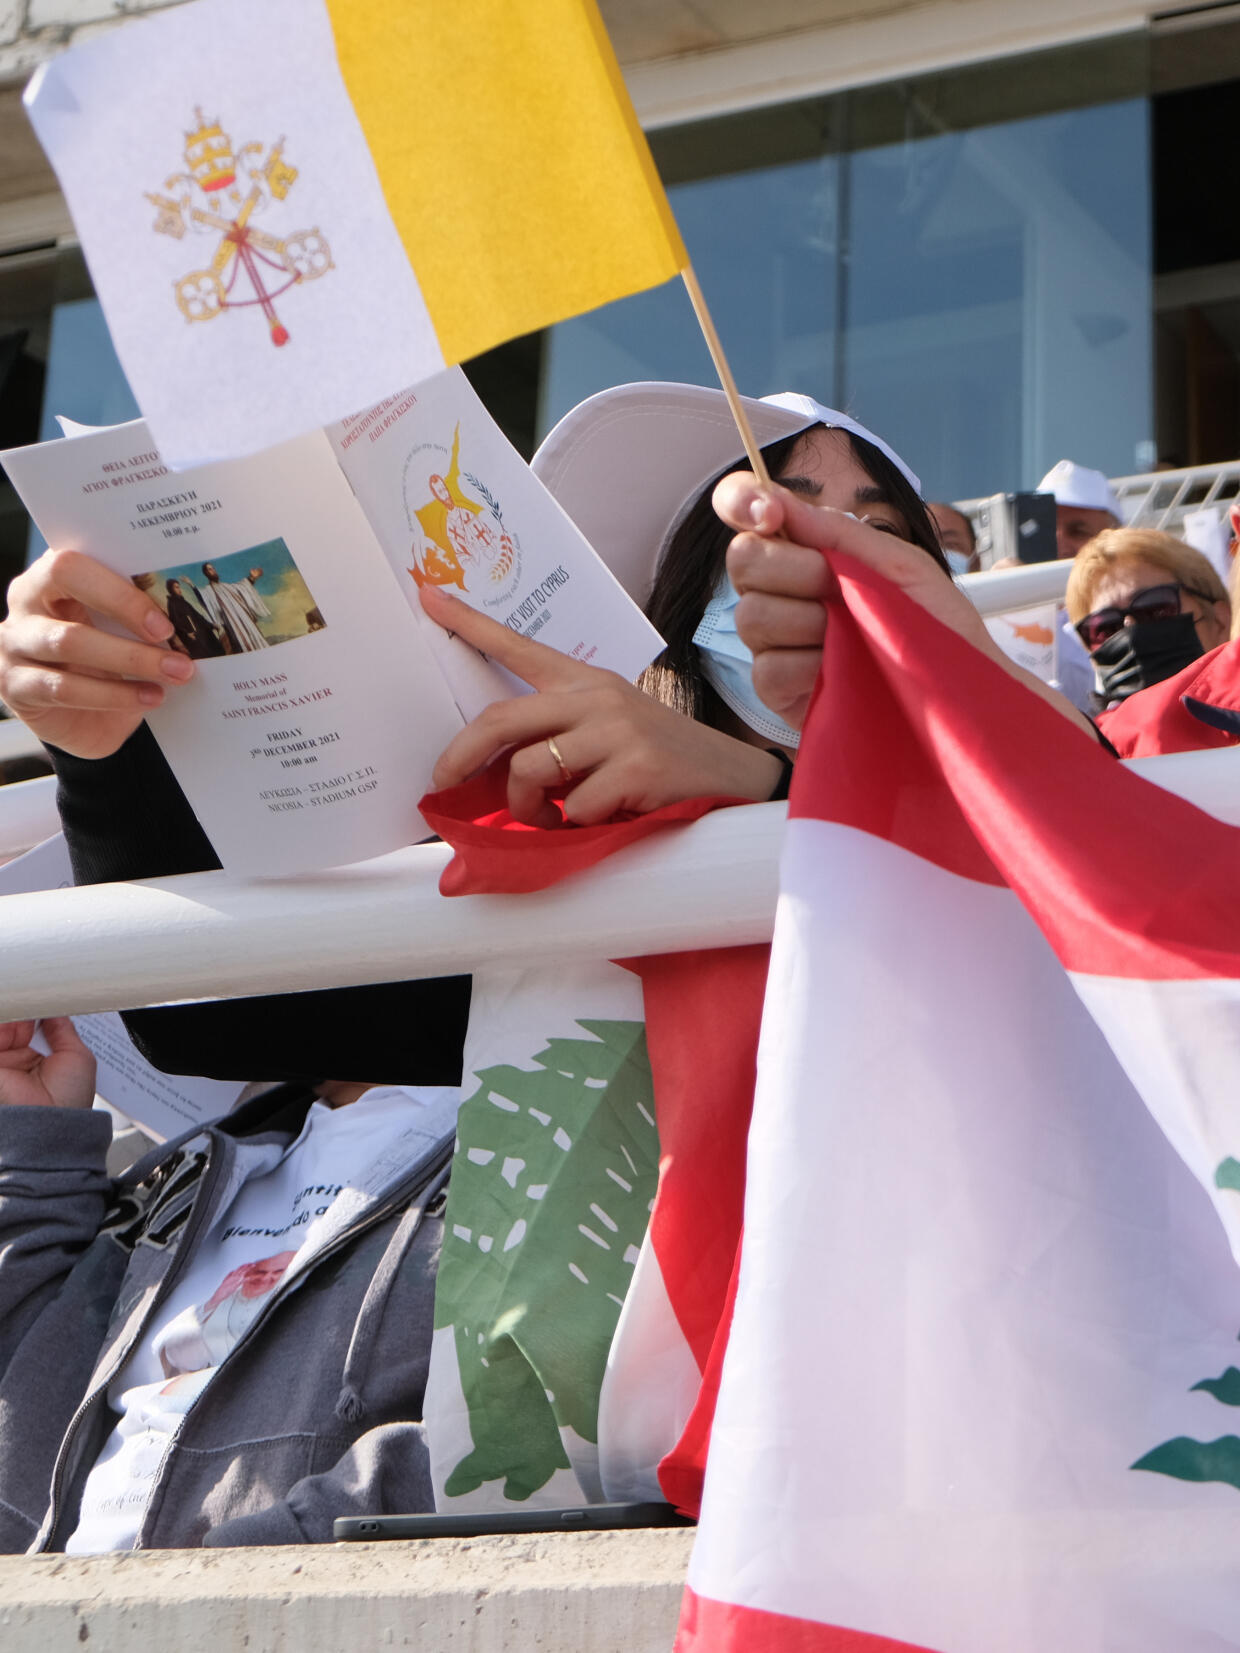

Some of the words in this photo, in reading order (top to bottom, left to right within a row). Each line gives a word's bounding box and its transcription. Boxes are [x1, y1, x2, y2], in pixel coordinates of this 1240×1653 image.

[102, 461, 127, 473] ΘΕΙΑ
[128, 450, 159, 466] ΛΕΙΤΟ
[82, 479, 110, 494] ΑΓΙΟΥ
[111, 465, 168, 487] ΦΡΑΓΚΙΣΚΟ
[136, 490, 198, 513] ΠΑΡΑΣΚΕΥΗ
[137, 506, 198, 529] ΔΕΚΕΜΒΡΙΟΥ
[201, 500, 222, 513] 2021
[516, 596, 538, 621] VISIT
[531, 588, 546, 606] TO
[540, 565, 570, 597] CYPRUS
[233, 679, 259, 691] HOLY
[259, 673, 288, 686] MASS
[222, 708, 248, 720] SAINT
[249, 701, 289, 717] FRANCIS
[290, 688, 333, 707] XAVIER
[244, 690, 277, 703] Memorial
[278, 688, 287, 697] of
[263, 739, 317, 758] DECEMBER
[318, 732, 341, 746] 2021
[267, 728, 303, 743] FRIDAY
[280, 758, 303, 769] 10:00
[303, 755, 318, 765] am
[259, 787, 302, 800] ΛΕΥΚΩΣΙΑ
[309, 776, 346, 793] ΣΤΑΔΙΟ
[268, 801, 304, 814] NICOSIA
[310, 788, 356, 807] STADIUM
[357, 780, 379, 795] GSP
